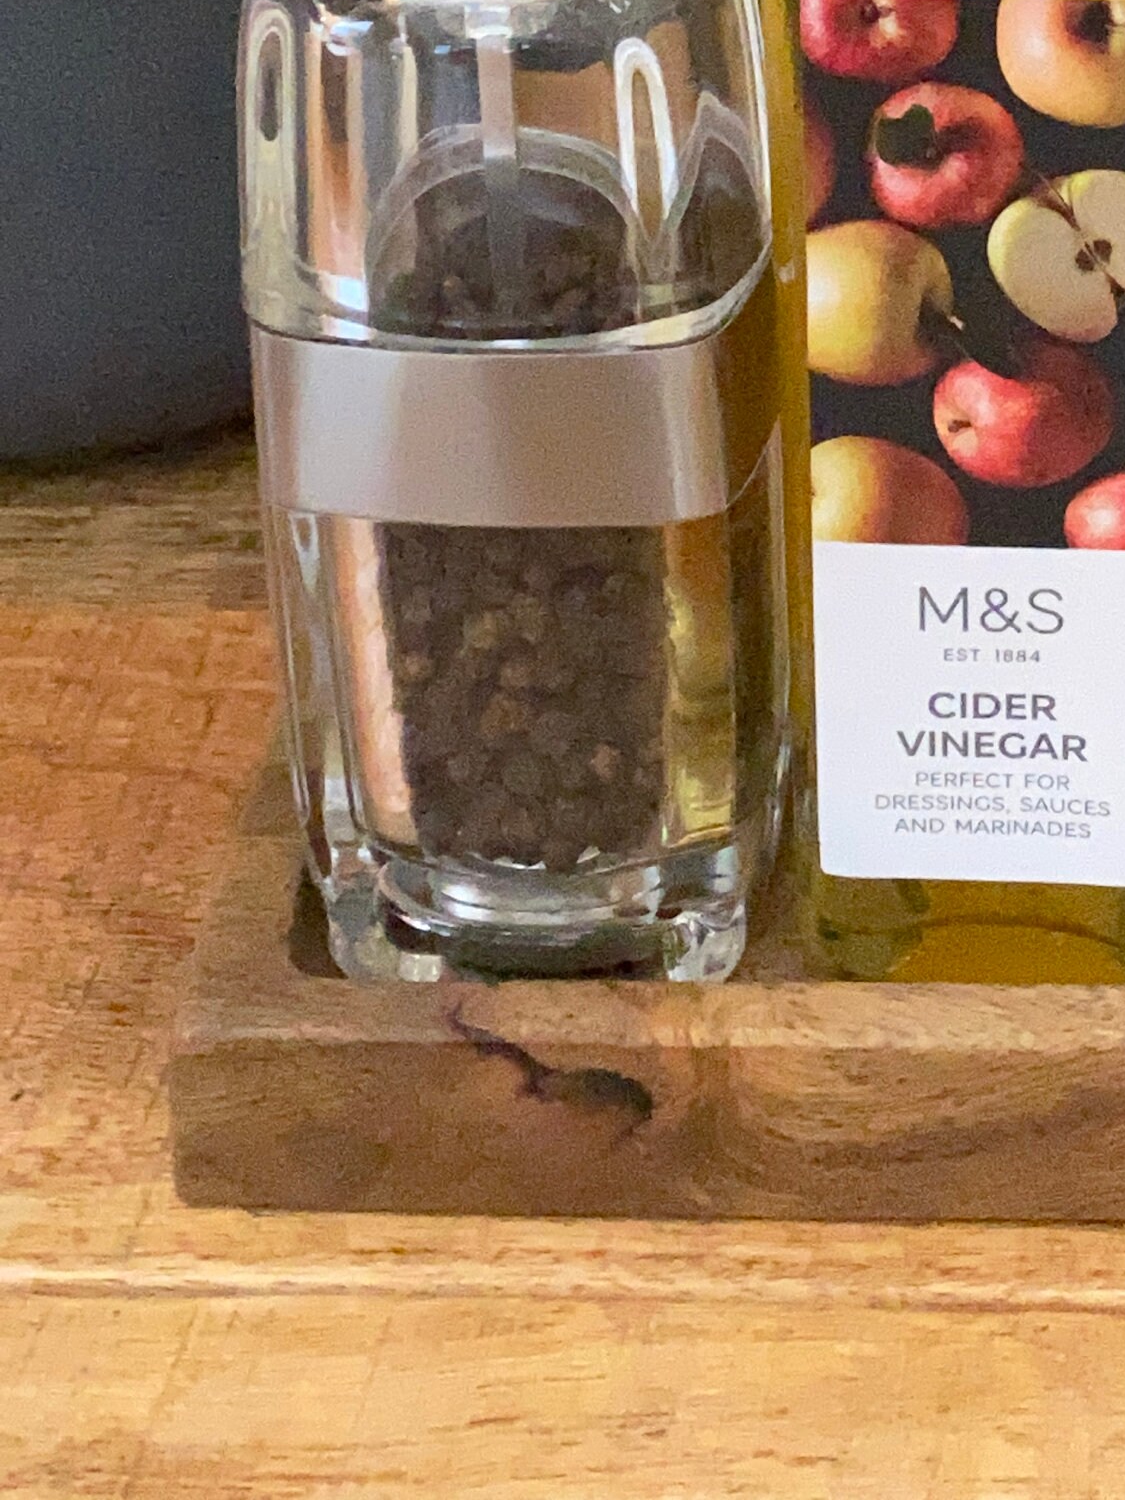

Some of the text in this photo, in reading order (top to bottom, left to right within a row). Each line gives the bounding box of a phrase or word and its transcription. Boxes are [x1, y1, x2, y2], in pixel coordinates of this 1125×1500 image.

[918, 585, 1064, 635] M&S
[943, 648, 1041, 663] EST 1884
[927, 691, 1058, 722] CIDER
[896, 729, 1088, 763] VINEGAR
[914, 771, 1070, 791] PERFECT FOR
[874, 794, 1111, 817] DRESSINGS, SAUCES
[894, 817, 1092, 839] AND MARINADES
